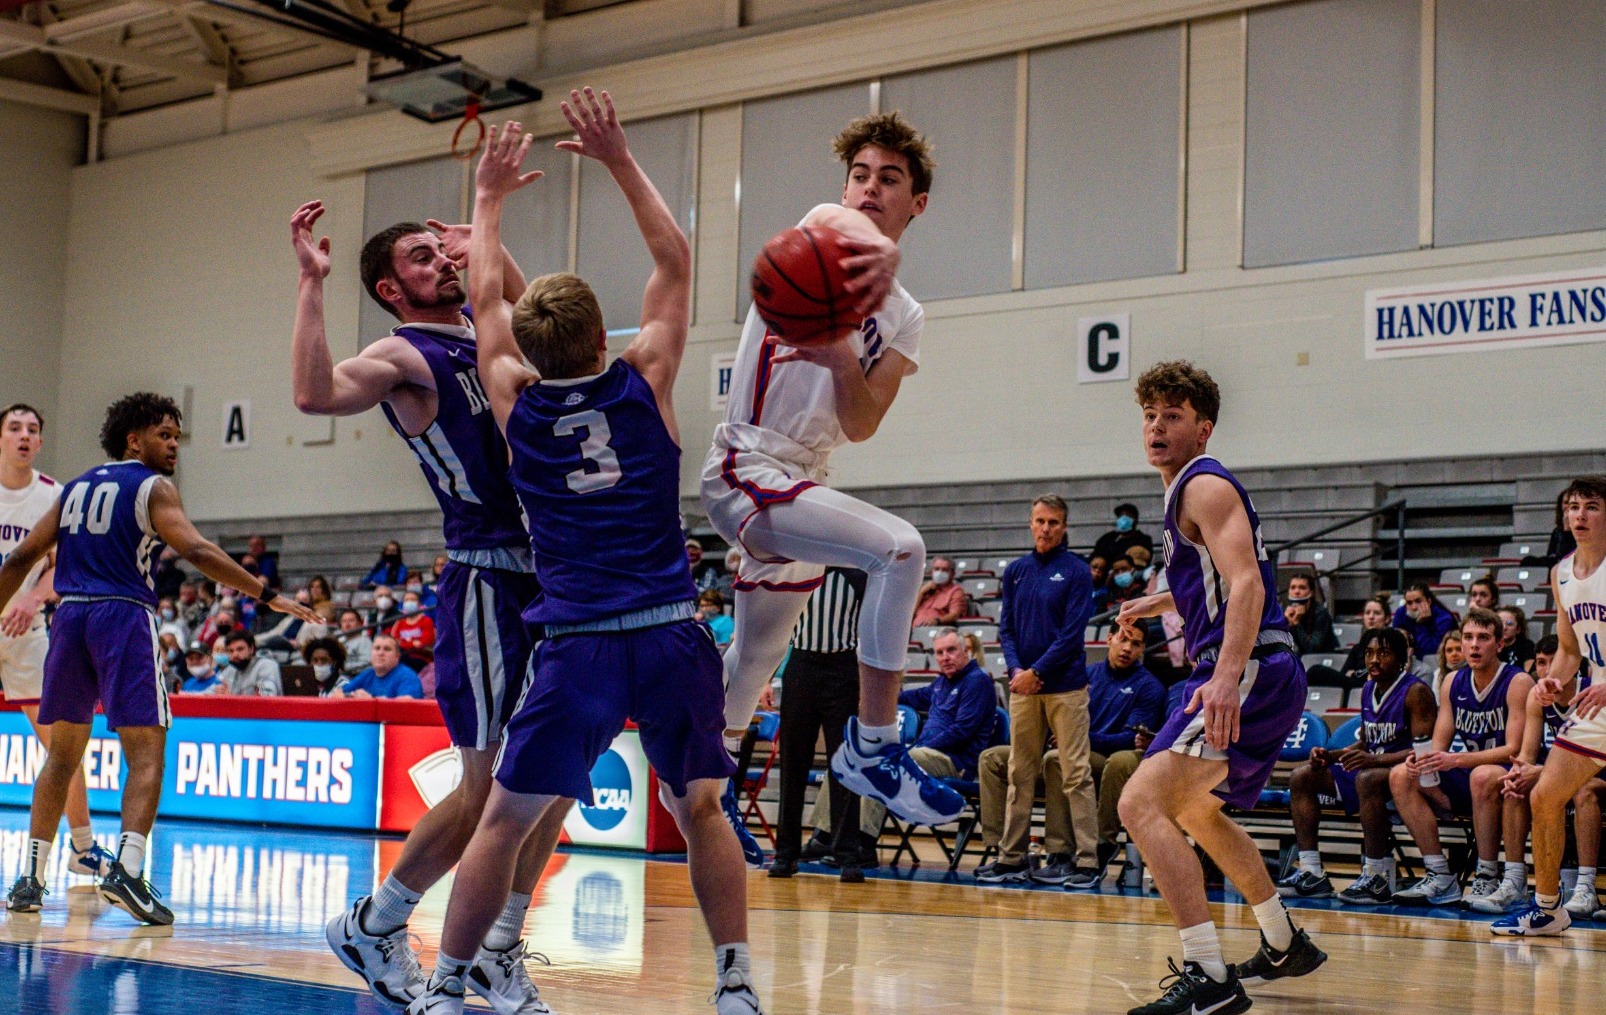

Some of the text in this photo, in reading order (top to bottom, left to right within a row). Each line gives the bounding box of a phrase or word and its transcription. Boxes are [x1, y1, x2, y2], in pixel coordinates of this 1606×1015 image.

[1375, 286, 1606, 341] HANOVER FANS
[1087, 322, 1120, 373] C
[225, 405, 245, 443] A
[553, 409, 623, 494] 3
[59, 481, 120, 535] 40
[0, 732, 354, 805] ANER PANTHERS
